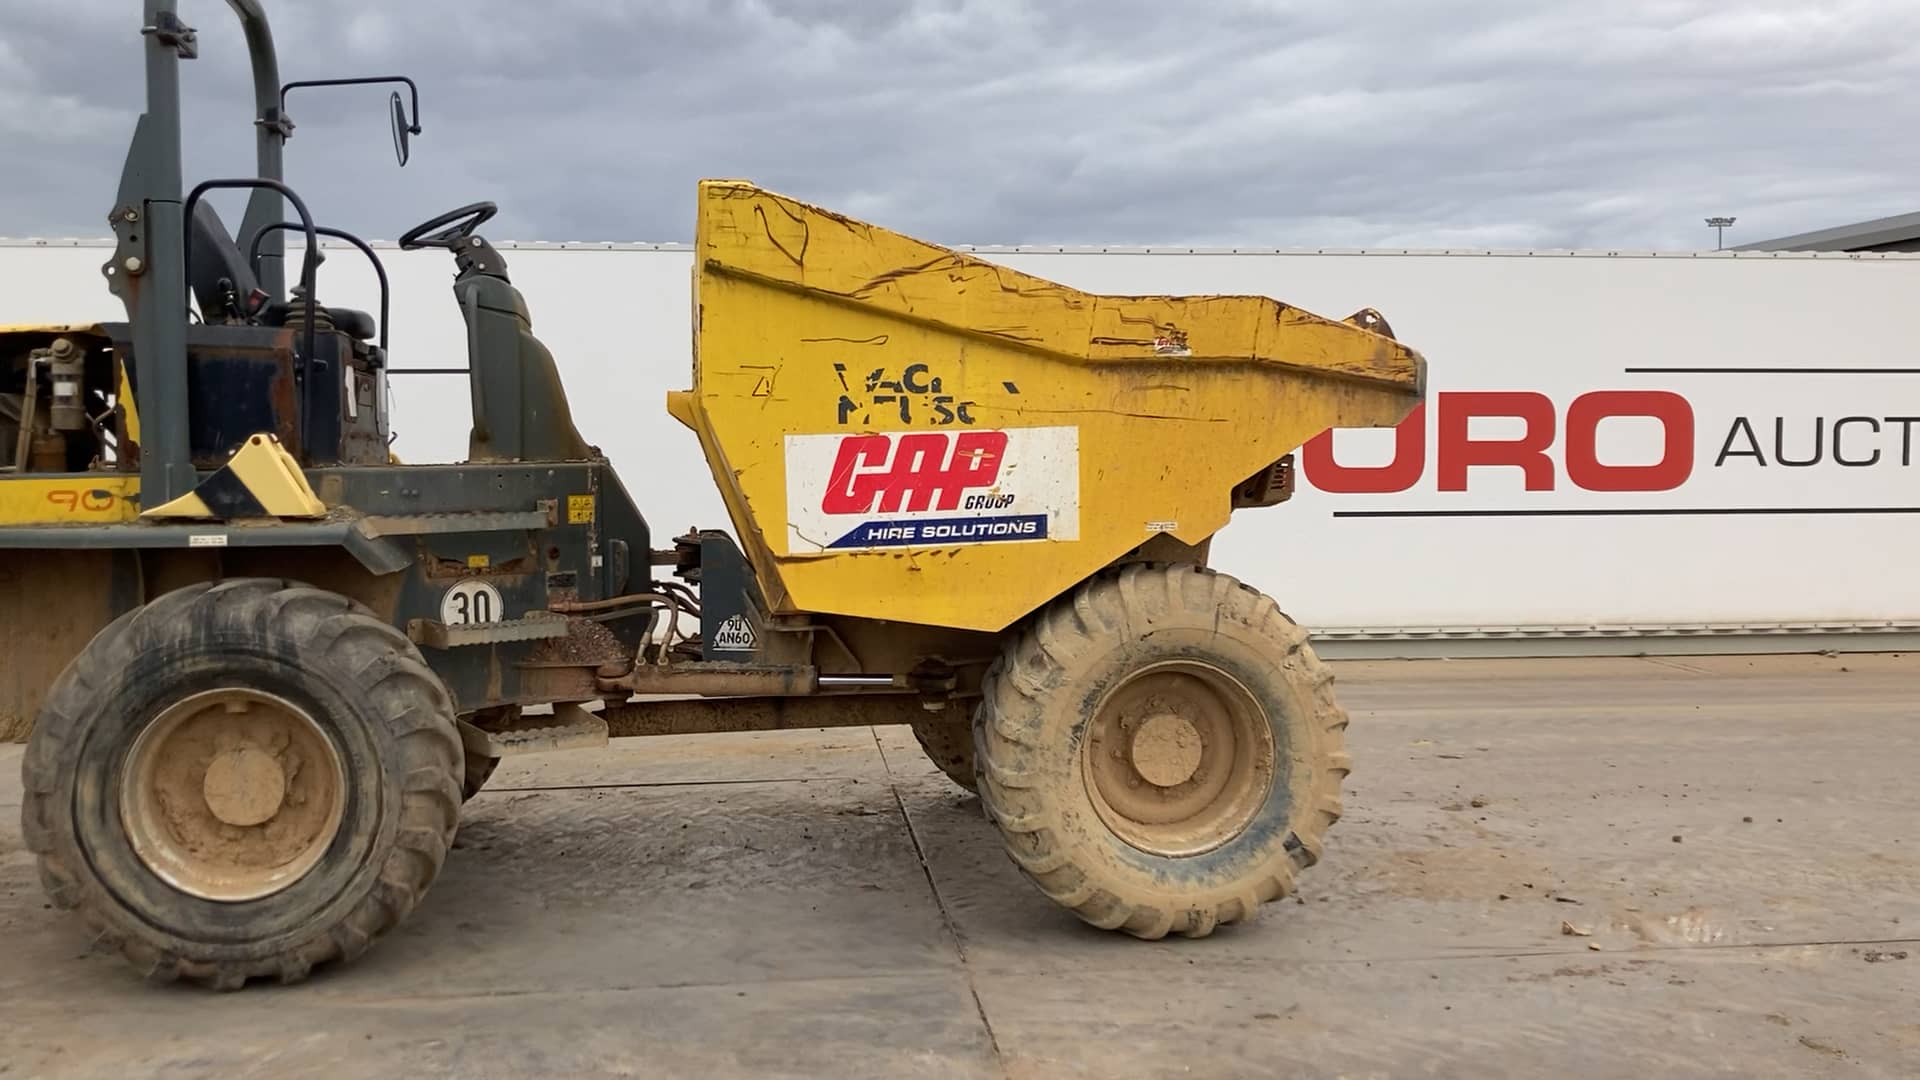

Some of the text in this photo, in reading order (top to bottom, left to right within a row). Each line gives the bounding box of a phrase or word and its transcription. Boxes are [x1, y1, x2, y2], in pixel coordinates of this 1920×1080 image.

[1714, 416, 1920, 467] AUCT
[821, 431, 1008, 515] GAP
[964, 494, 1015, 510] GROUP
[867, 522, 1037, 540] HIRE SOLUTIONS
[452, 590, 491, 625] 30
[719, 631, 751, 644] AN60
